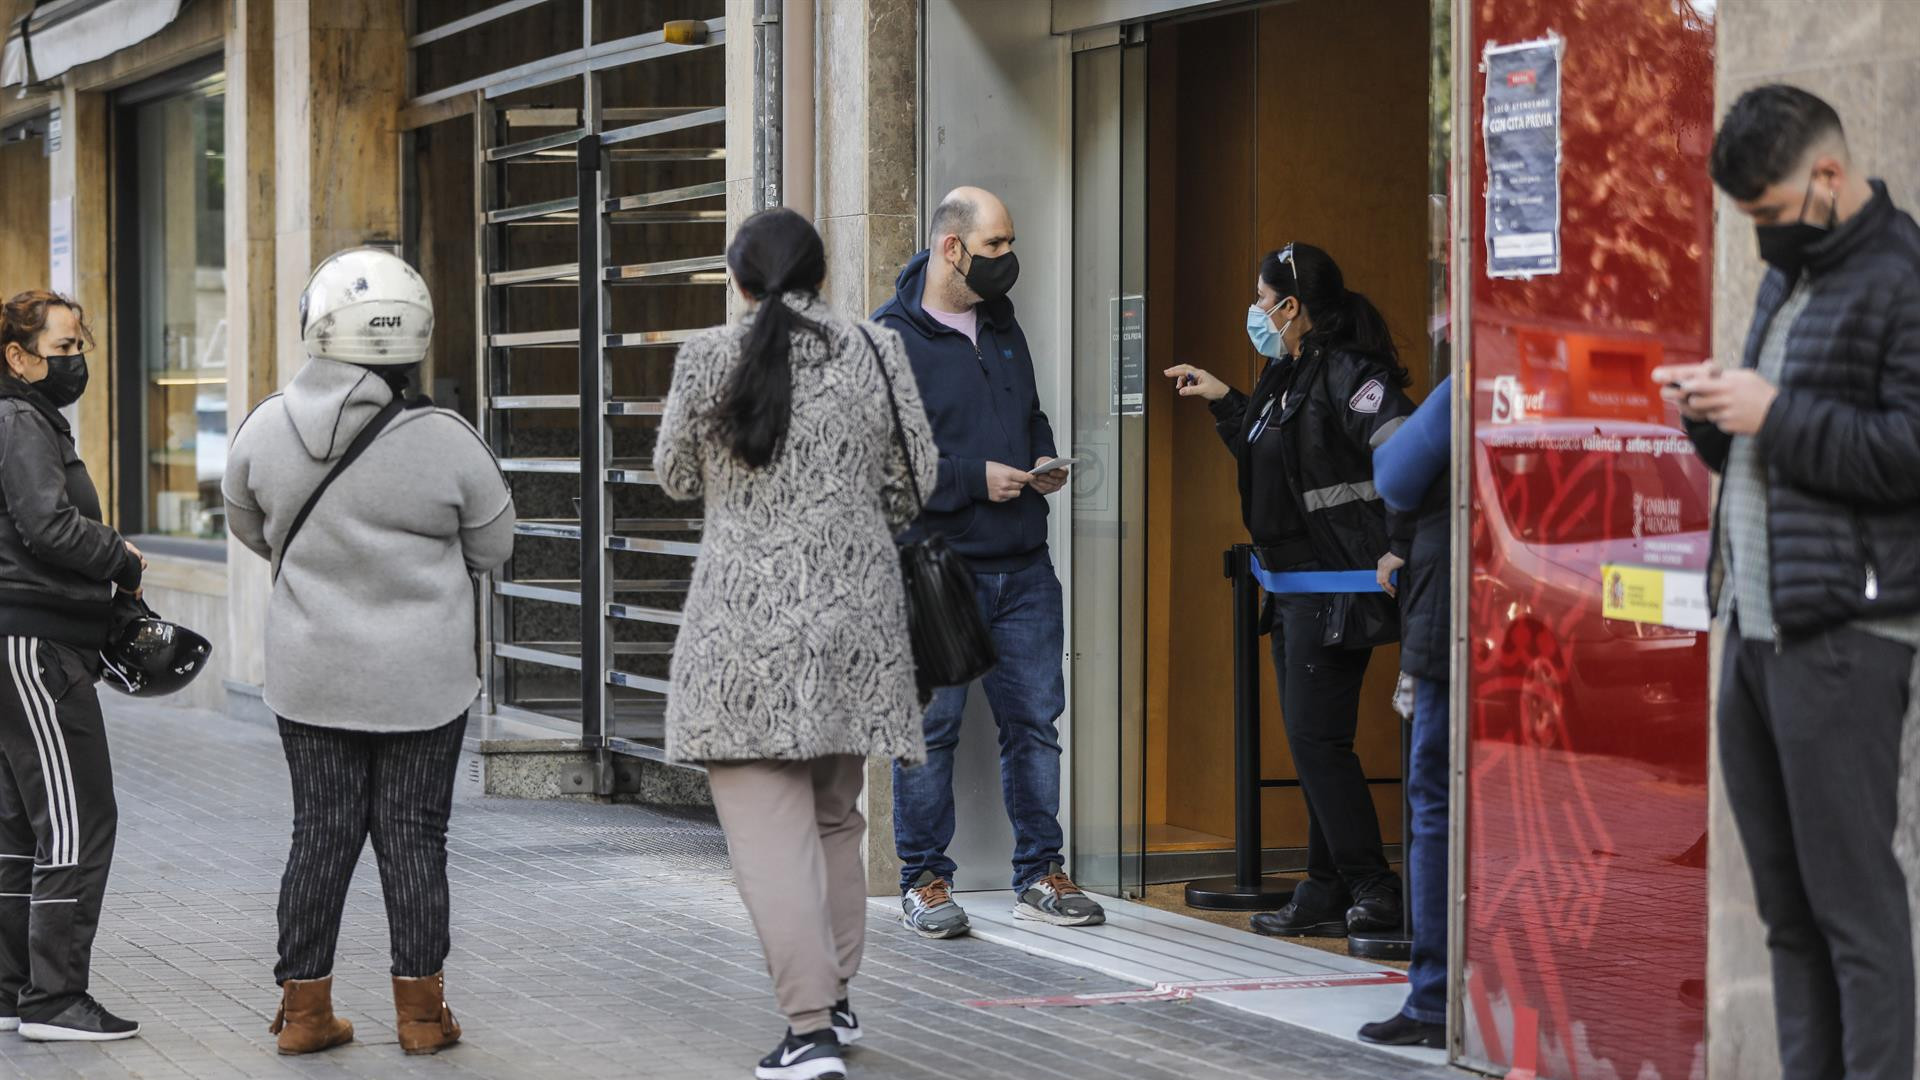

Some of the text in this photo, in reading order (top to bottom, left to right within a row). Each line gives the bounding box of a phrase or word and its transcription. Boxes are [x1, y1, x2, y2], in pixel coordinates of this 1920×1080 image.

[1489, 111, 1552, 133] CON CITA PREVIA
[369, 316, 401, 328] GIVI
[1626, 436, 1653, 454] artes
